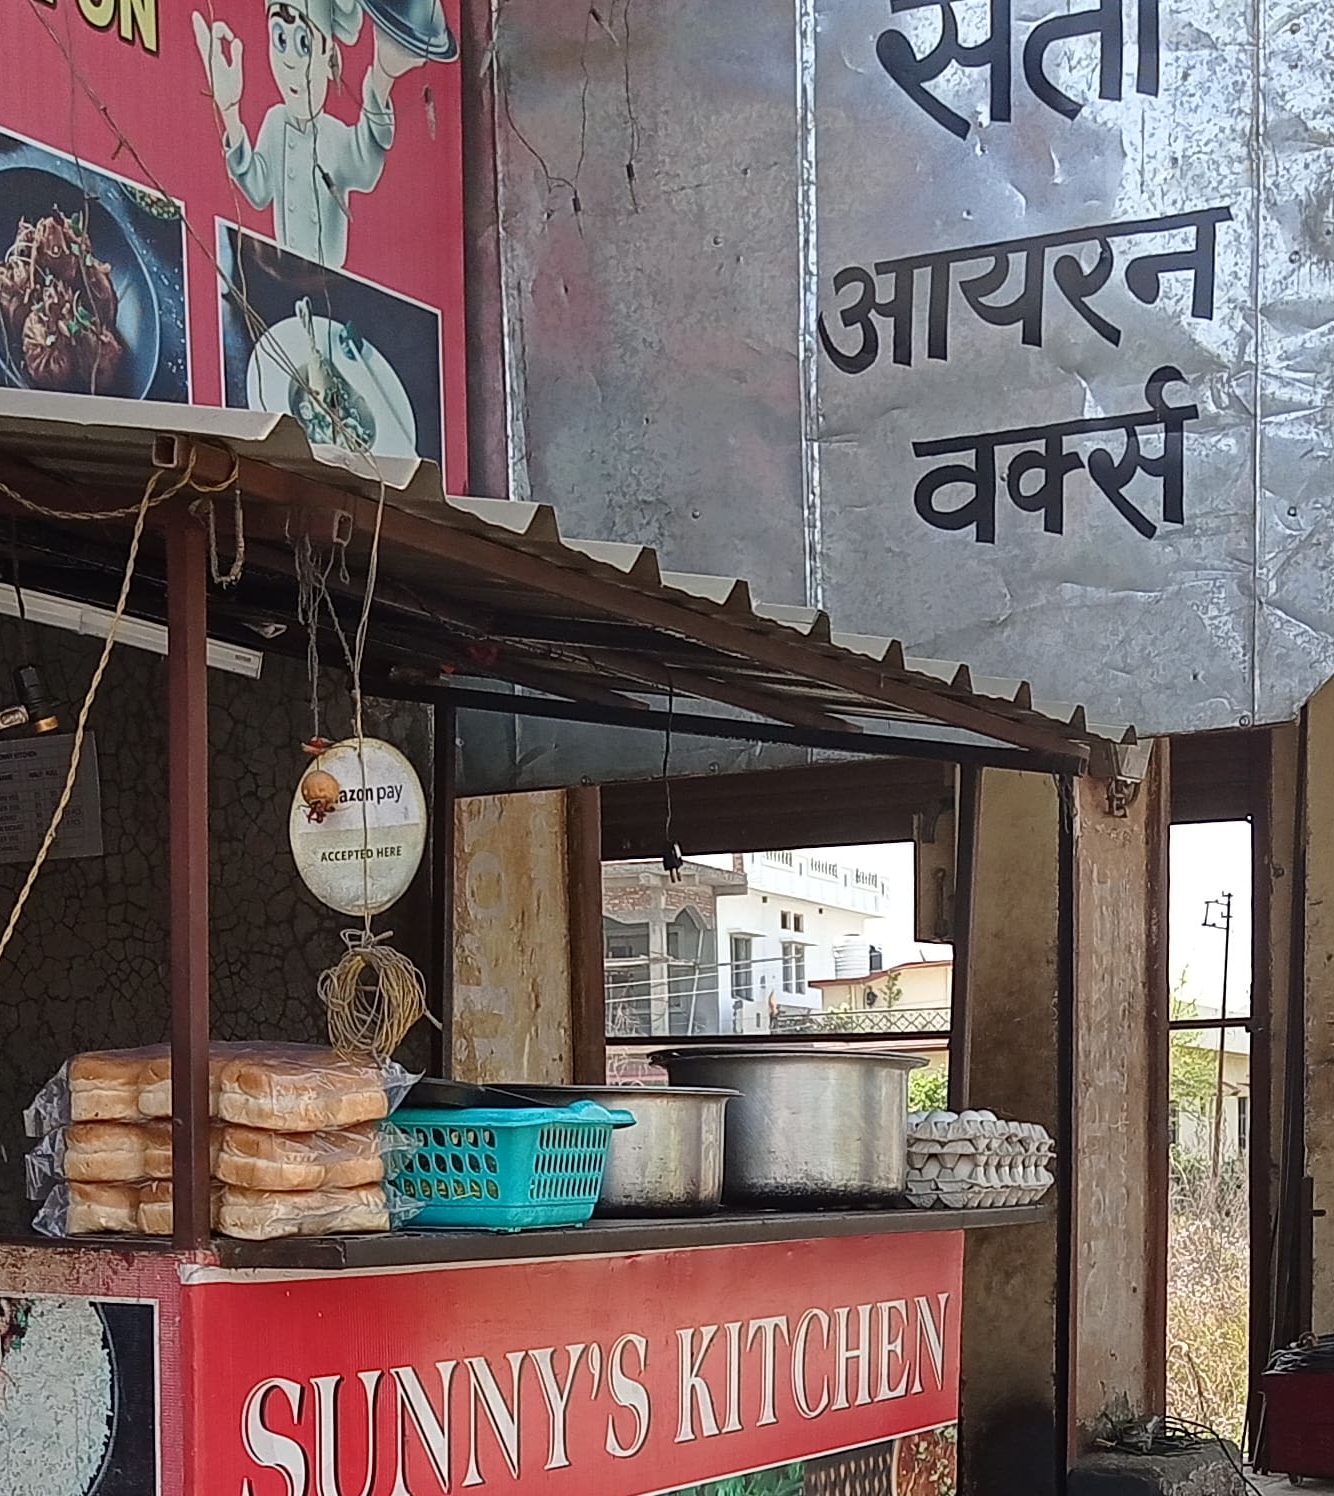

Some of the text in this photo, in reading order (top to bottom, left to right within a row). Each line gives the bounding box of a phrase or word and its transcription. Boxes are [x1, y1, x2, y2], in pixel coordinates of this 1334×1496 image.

[818, 206, 1233, 375] आयरन
[912, 365, 1199, 545] वर्क्स
[321, 846, 402, 862] ACCEPTED HERE
[336, 784, 403, 805] azon pay
[672, 1292, 951, 1444] KITCHEN
